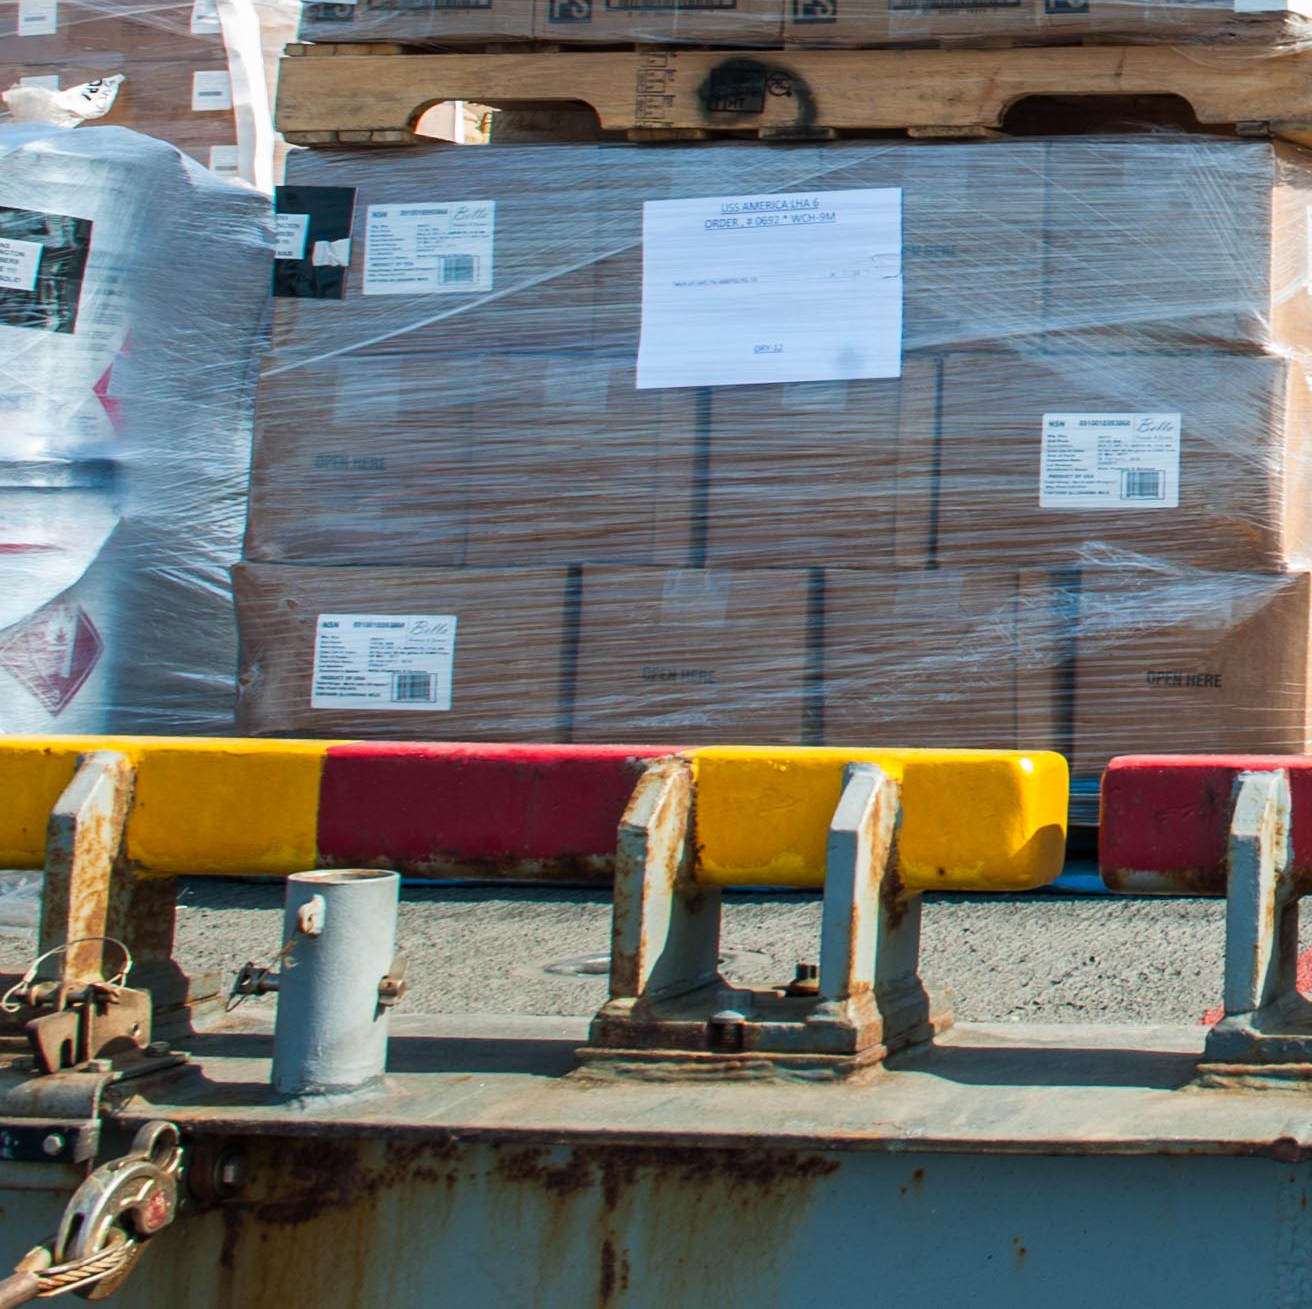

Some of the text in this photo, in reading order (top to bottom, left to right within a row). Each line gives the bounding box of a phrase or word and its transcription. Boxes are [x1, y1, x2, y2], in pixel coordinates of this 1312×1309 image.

[720, 203, 741, 214] USS
[742, 201, 789, 212] AMERICA
[791, 199, 810, 210] LHA
[704, 218, 738, 230] ORDER
[754, 215, 780, 227] 0692
[791, 212, 837, 224] WCH-9M
[1048, 420, 1066, 428] NSN
[1146, 671, 1223, 688] OPEN HERE
